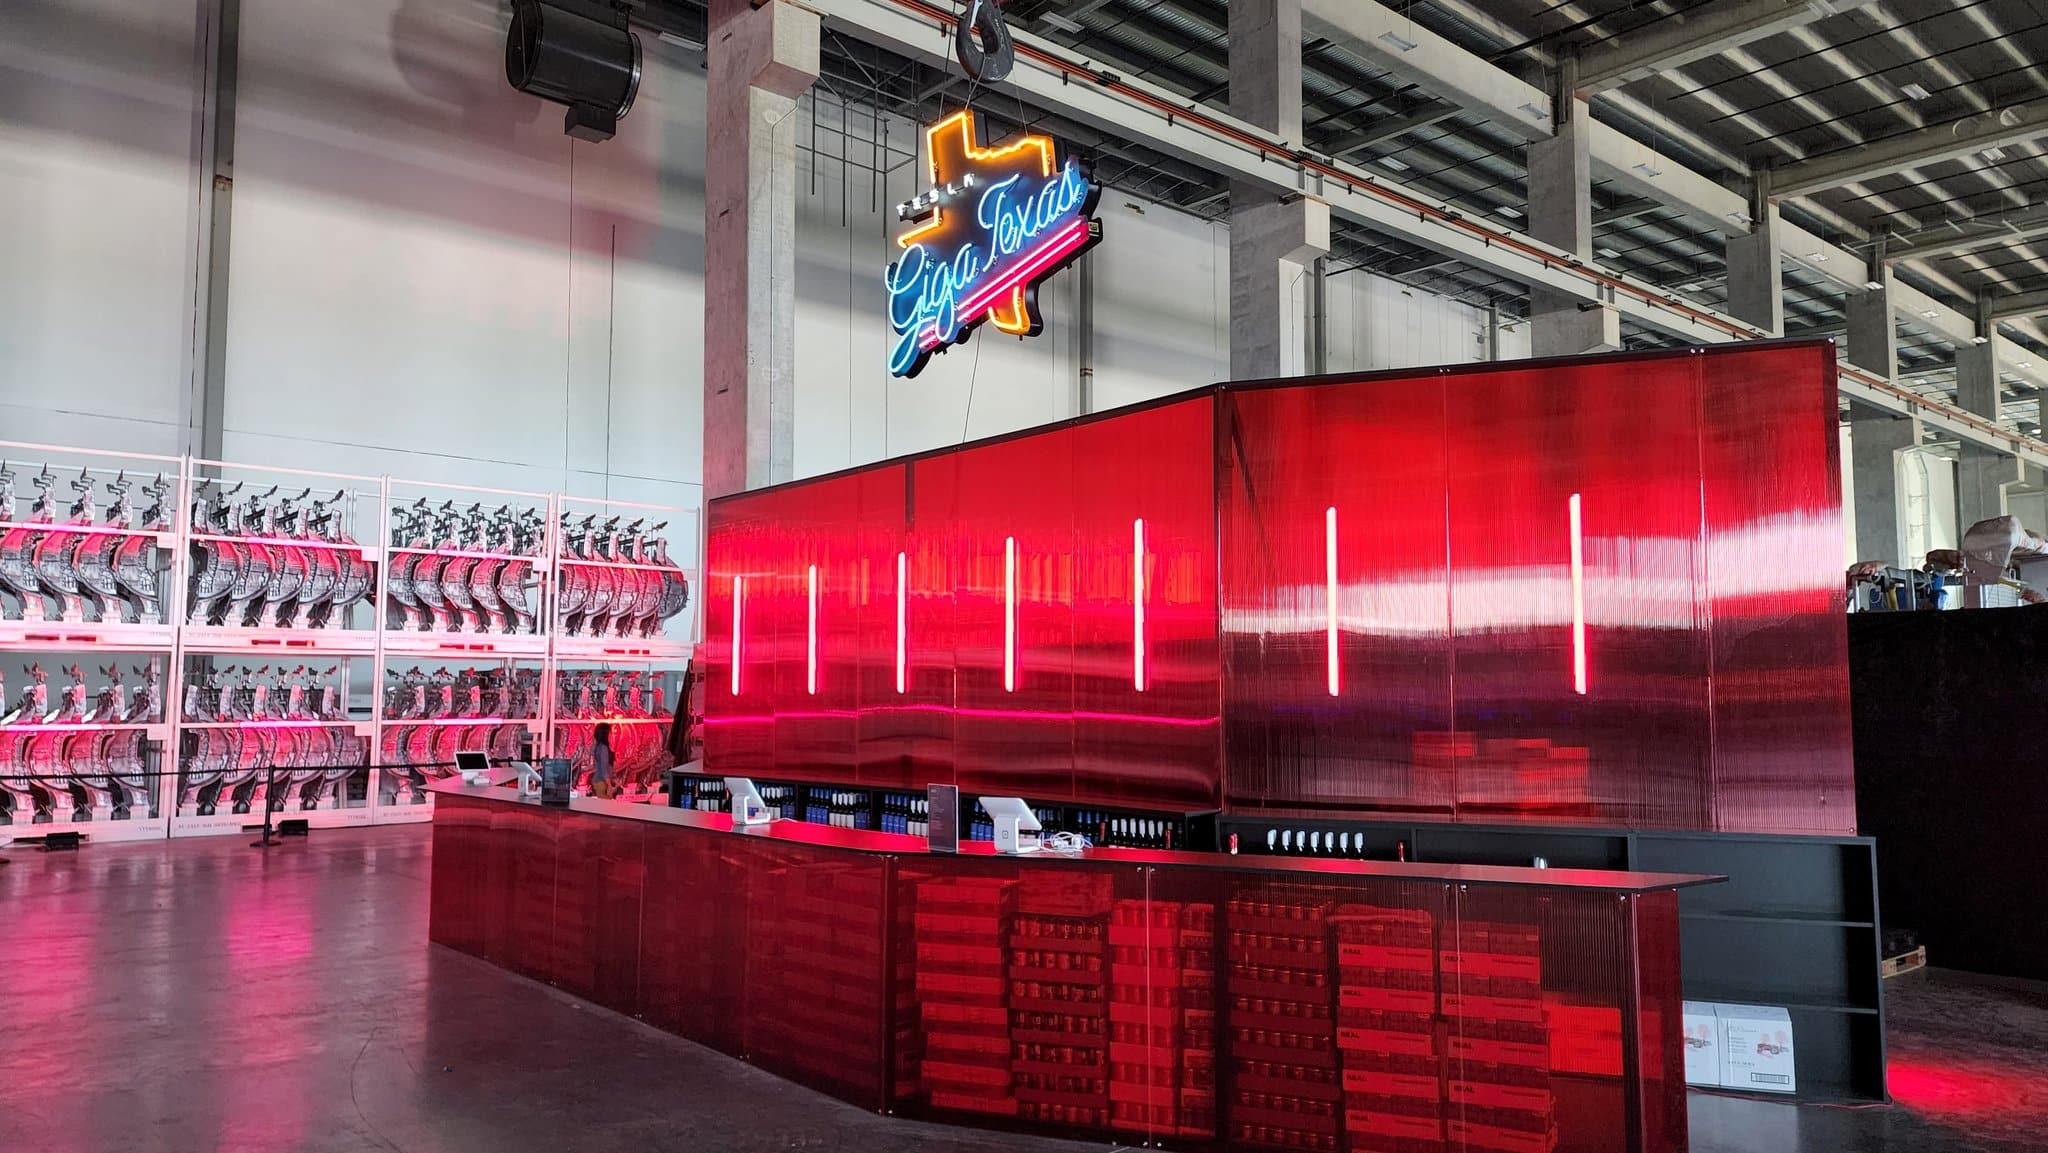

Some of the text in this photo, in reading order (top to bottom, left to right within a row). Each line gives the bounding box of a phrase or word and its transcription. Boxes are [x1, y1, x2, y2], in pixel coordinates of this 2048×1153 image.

[896, 173, 975, 216] TESLA
[885, 160, 1082, 373] Giga Texas
